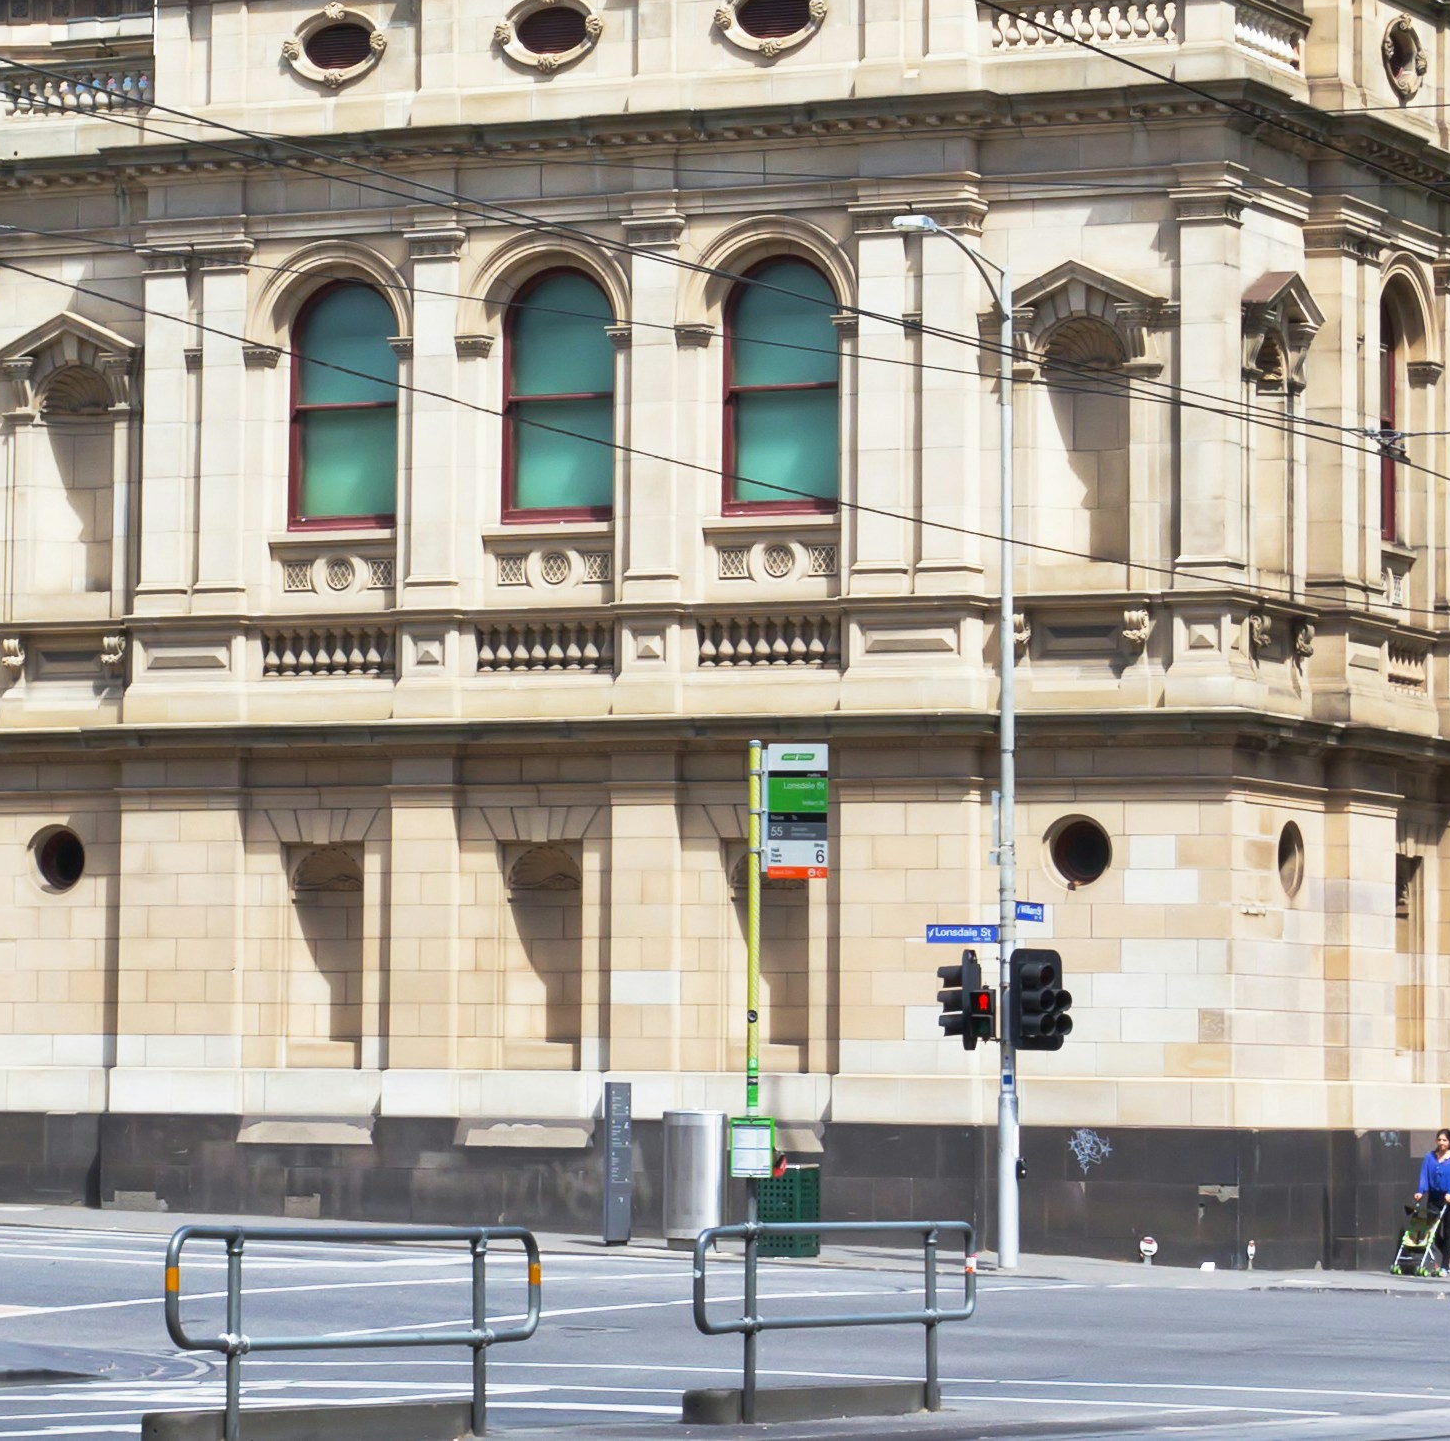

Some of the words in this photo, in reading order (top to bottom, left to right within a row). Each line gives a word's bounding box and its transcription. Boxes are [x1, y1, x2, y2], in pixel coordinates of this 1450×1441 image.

[783, 781, 815, 789] Lonsdale
[770, 826, 783, 837] 55
[815, 849, 825, 864] 6
[935, 927, 978, 937] Lonsdale
[980, 927, 991, 937] St
